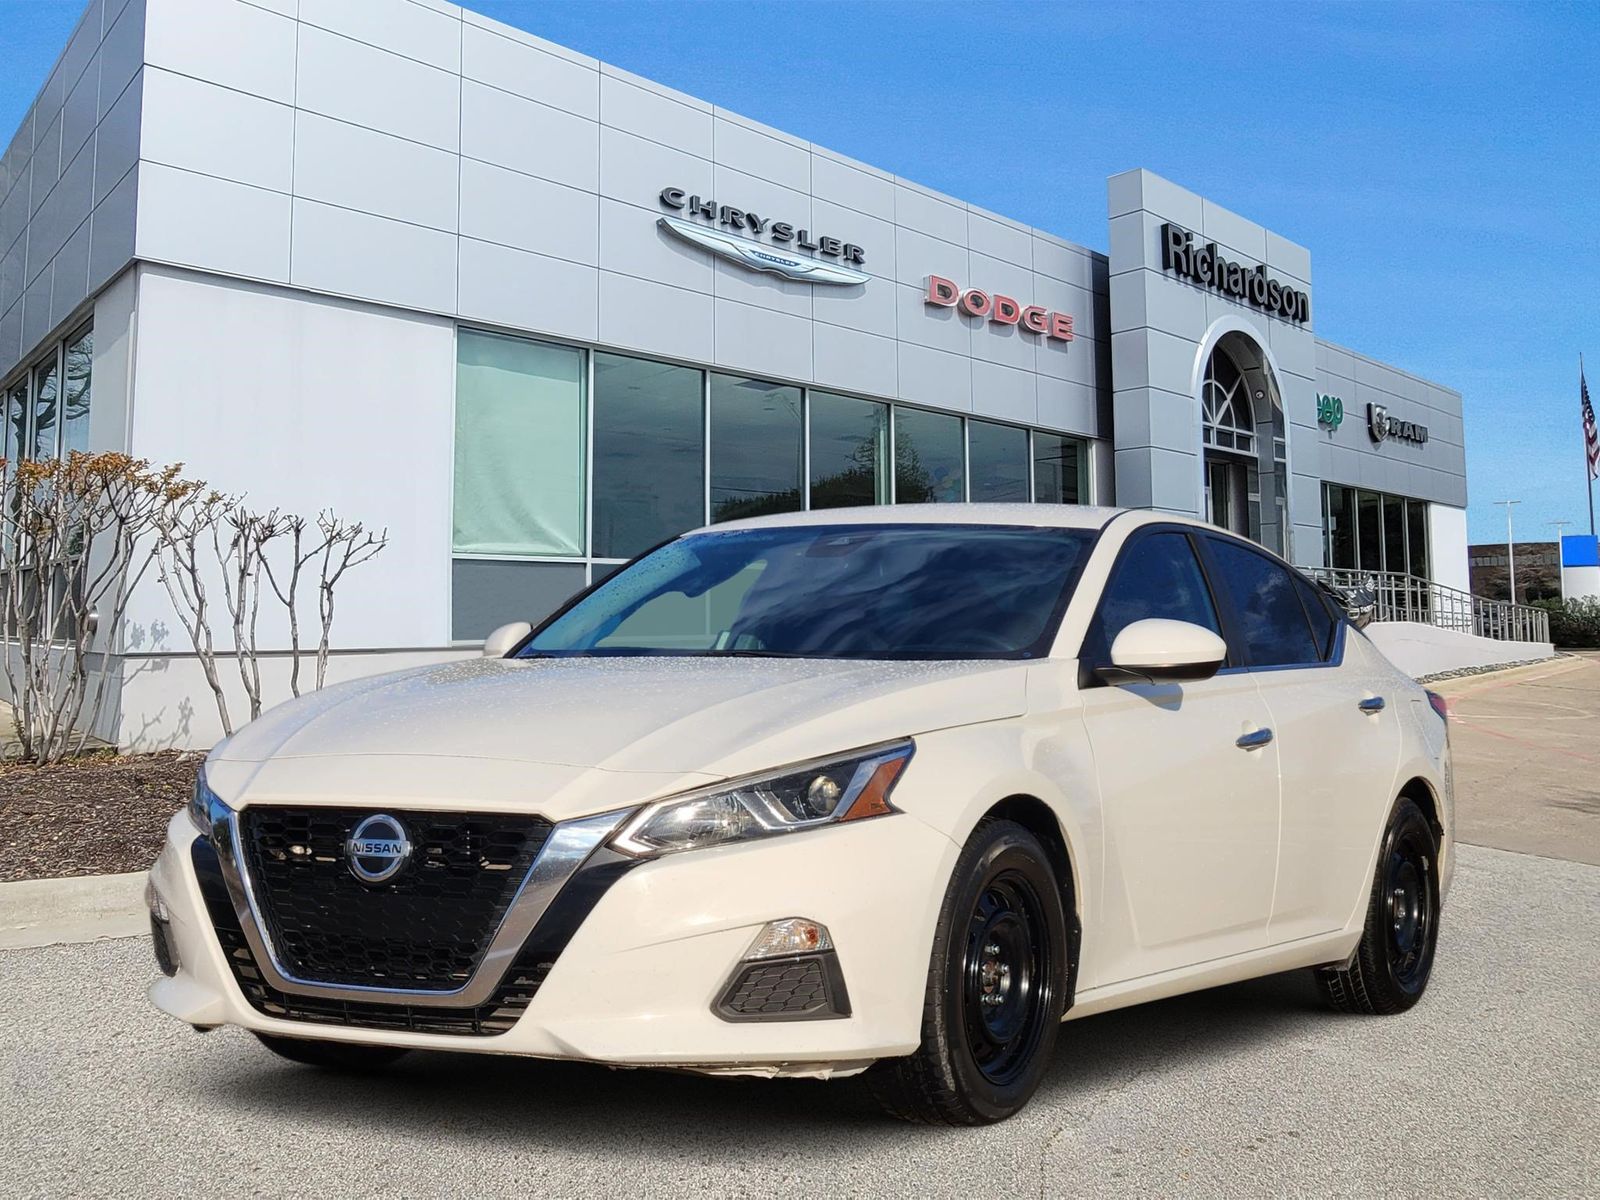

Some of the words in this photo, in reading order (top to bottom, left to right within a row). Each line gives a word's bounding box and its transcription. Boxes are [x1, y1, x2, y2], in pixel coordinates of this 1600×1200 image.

[660, 187, 866, 264] CHRYSLER
[1161, 223, 1309, 323] Richardson
[924, 275, 1074, 342] DODGE
[1387, 416, 1428, 443] RAM
[352, 843, 402, 853] NISSAN
